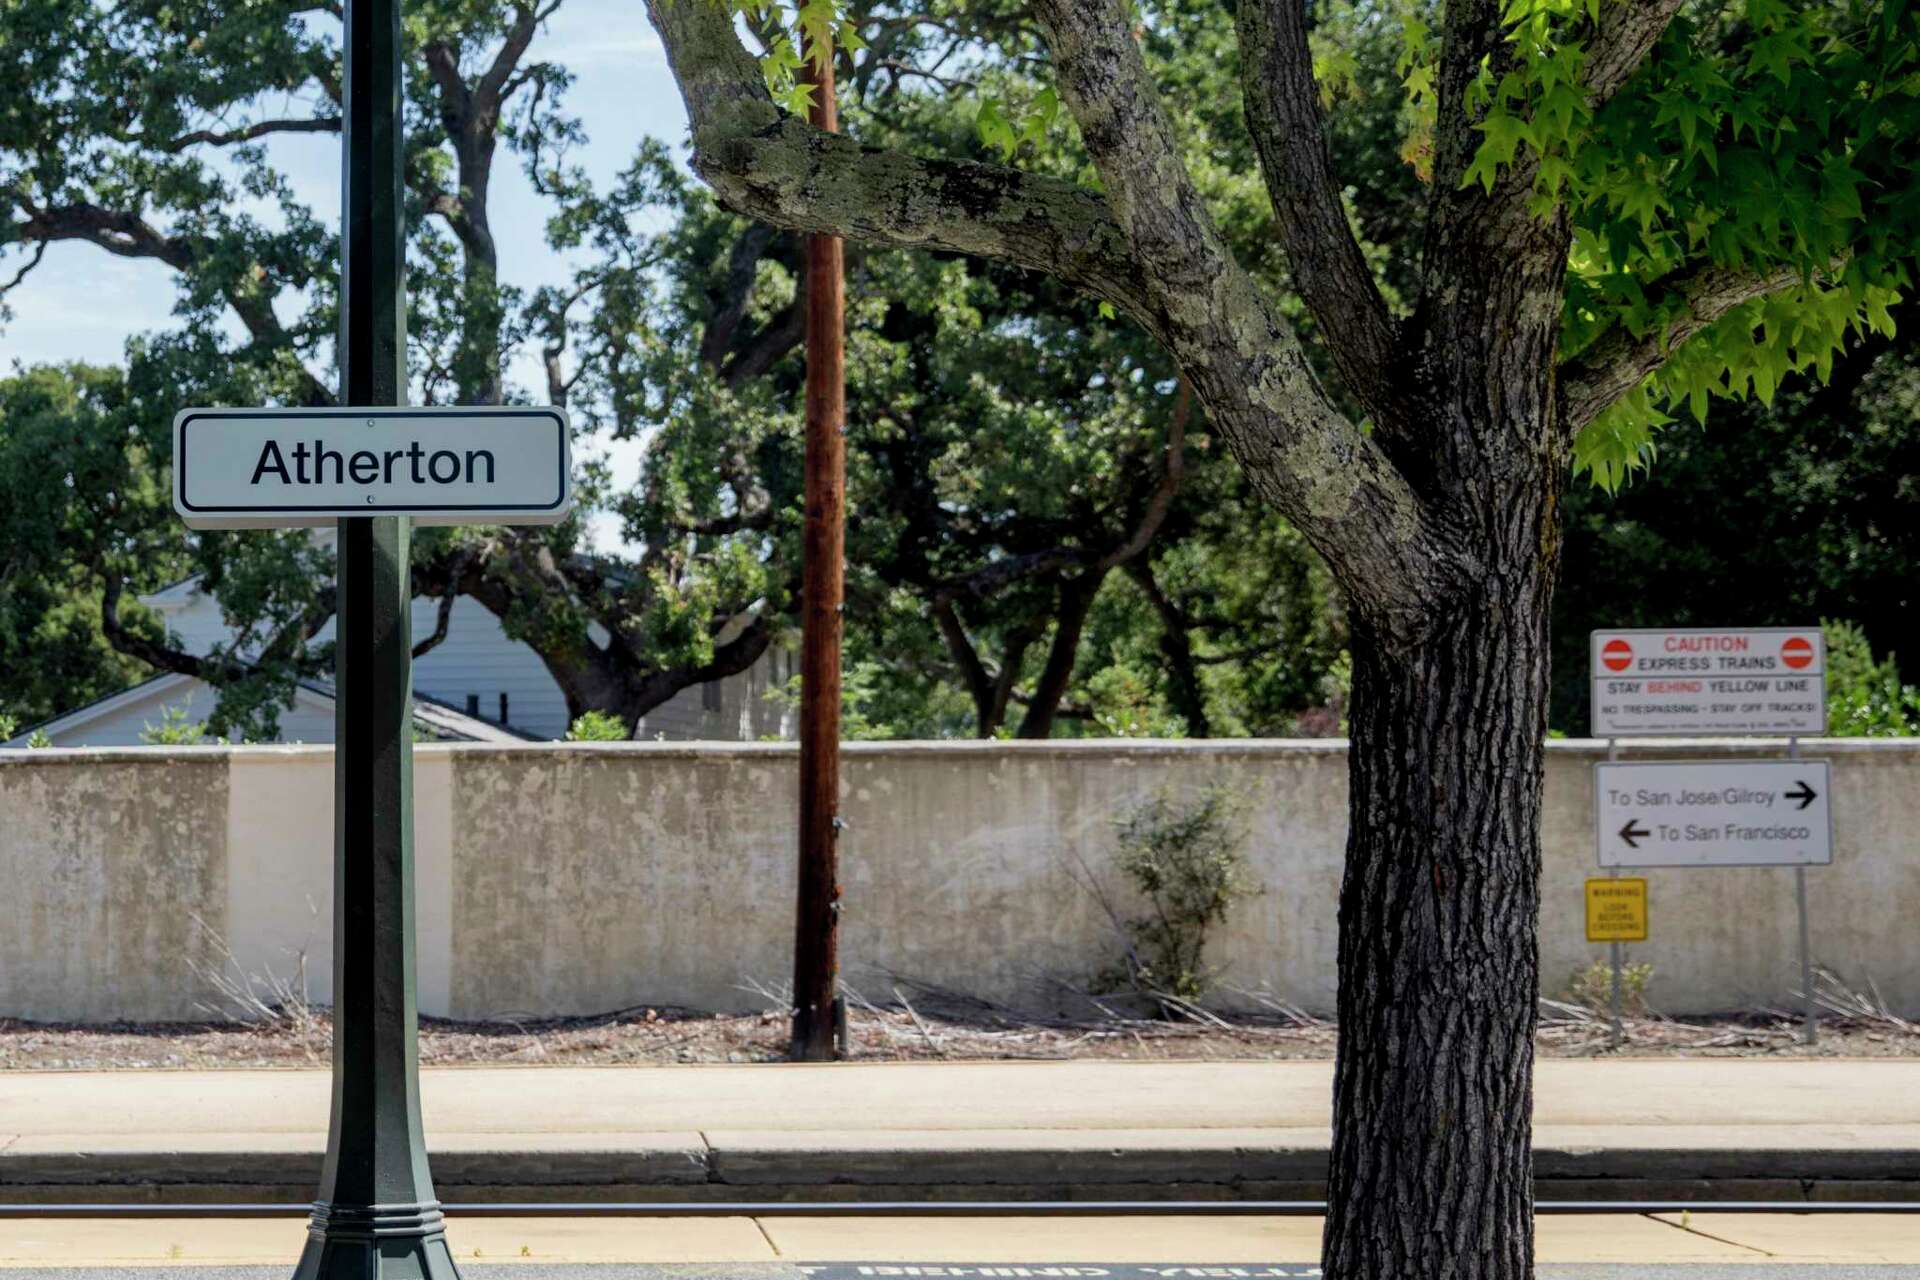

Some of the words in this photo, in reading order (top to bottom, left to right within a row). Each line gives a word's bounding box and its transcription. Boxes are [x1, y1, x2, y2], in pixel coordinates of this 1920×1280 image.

[250, 439, 496, 485] Atherton
[1664, 636, 1748, 653] CAUTION
[1638, 657, 1711, 672] EXPRESS
[1718, 655, 1777, 670] TRAINS
[1607, 682, 1642, 695] STAY
[1647, 681, 1702, 694] BEHIND
[1709, 680, 1769, 693] YELLOW
[1775, 679, 1809, 692] LINE
[1623, 703, 1699, 715] TRESPASSING
[1608, 789, 1631, 806] To
[1636, 788, 1671, 806] San
[1657, 824, 1680, 842] To
[1684, 823, 1719, 841] San
[1725, 822, 1811, 841] Francisco
